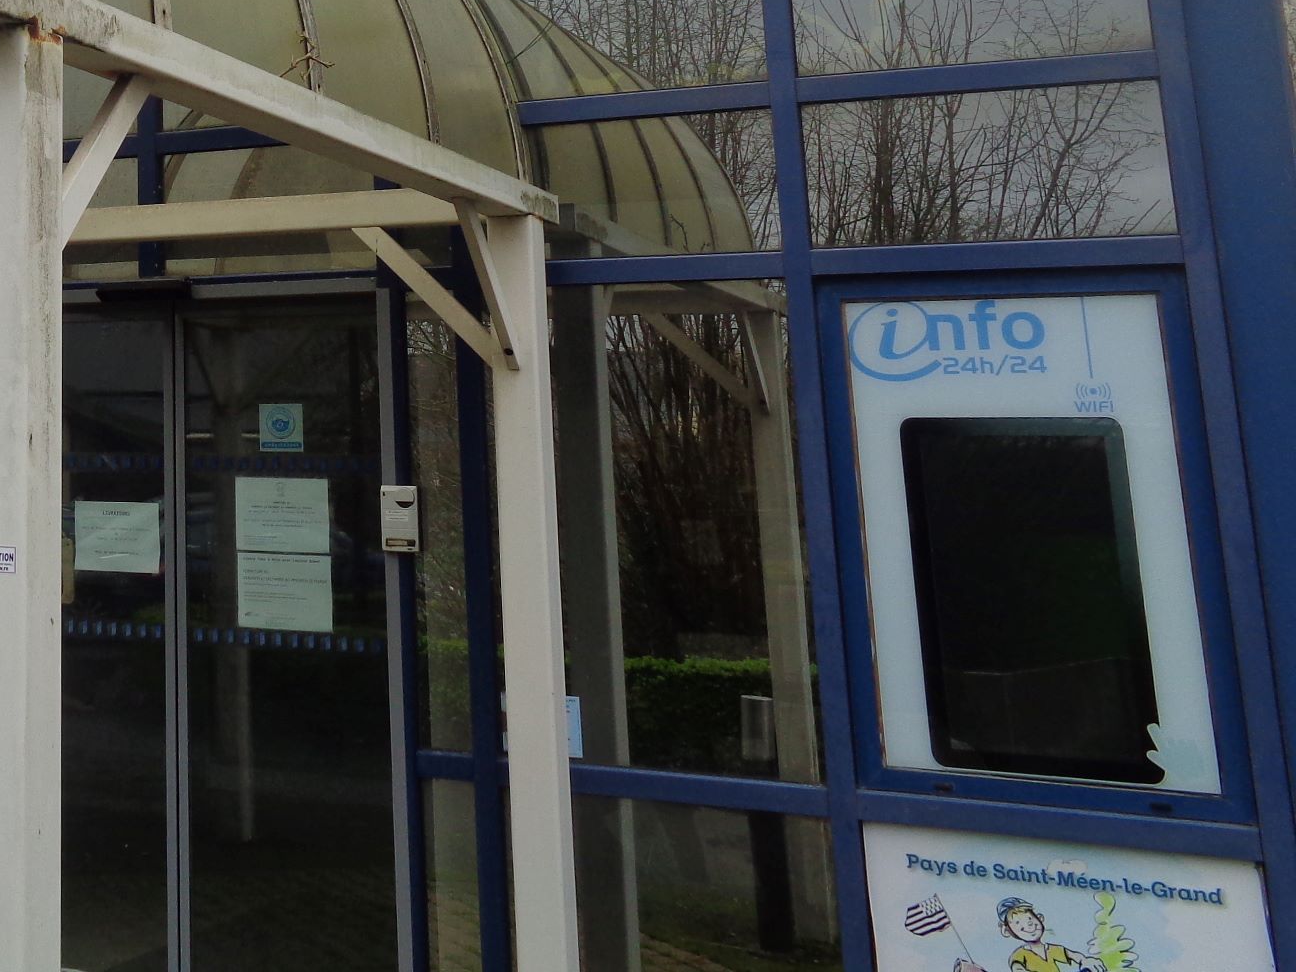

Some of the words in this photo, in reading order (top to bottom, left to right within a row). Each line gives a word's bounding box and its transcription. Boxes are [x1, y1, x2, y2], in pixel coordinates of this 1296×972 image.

[942, 354, 1048, 376] 24h/24
[1074, 401, 1114, 413] WIFI
[905, 853, 957, 877] Pays
[963, 860, 988, 878] de
[993, 863, 1225, 906] Saint-Méen-le-Grand
